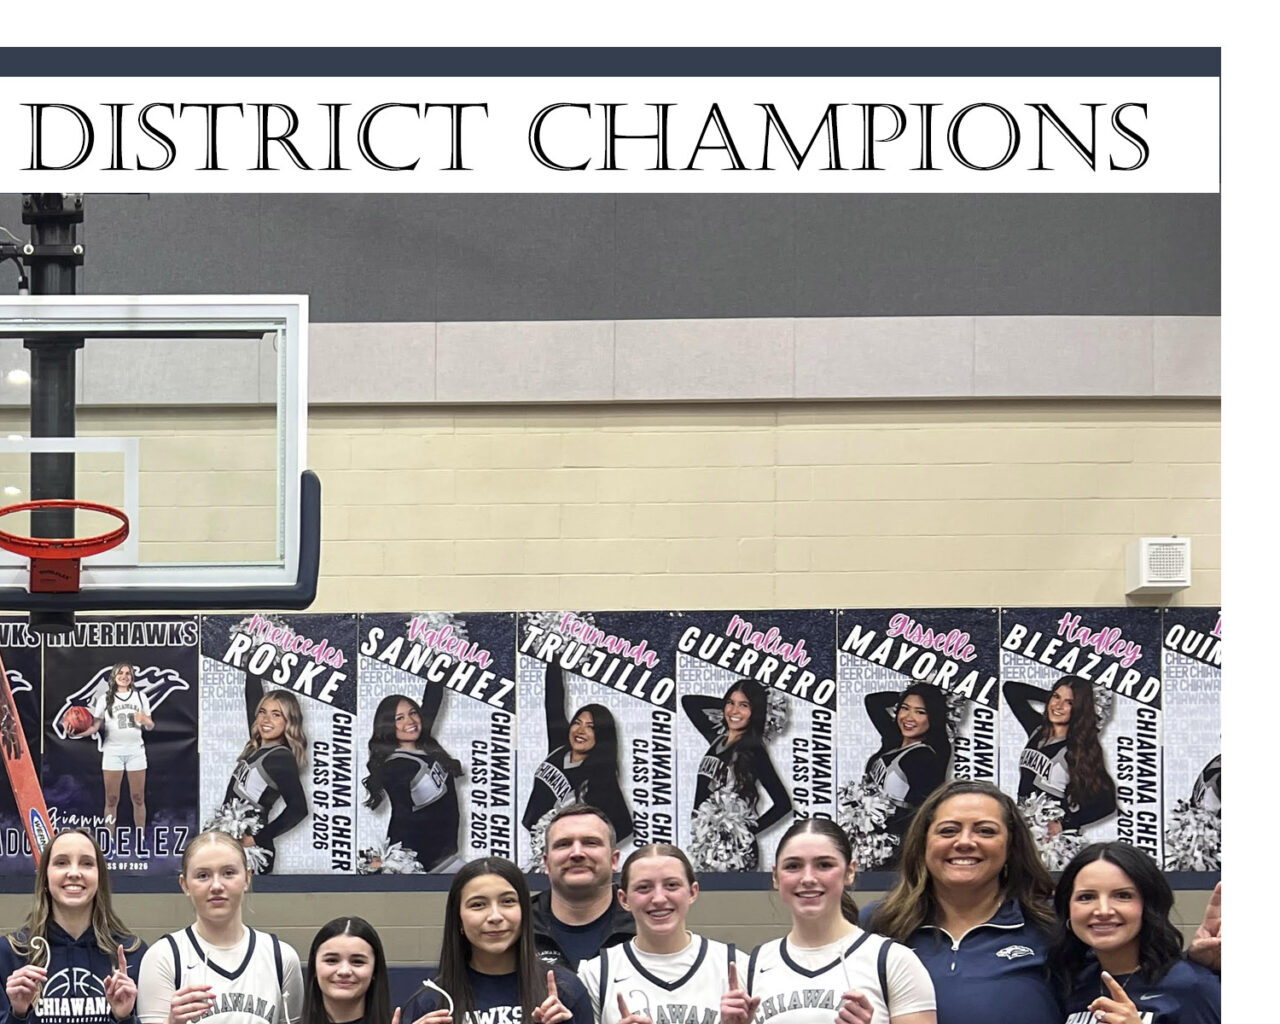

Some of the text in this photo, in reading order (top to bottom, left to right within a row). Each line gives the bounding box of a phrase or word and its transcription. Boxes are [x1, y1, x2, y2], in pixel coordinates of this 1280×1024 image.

[222, 632, 348, 704] ROSKE
[248, 613, 348, 669] Mercedes
[360, 626, 515, 709] SANCHEZ
[409, 617, 494, 670] Valeria
[519, 624, 675, 706] TRUJILLO
[559, 612, 660, 668] Fernanda
[678, 626, 836, 705] GUERRERO
[725, 614, 811, 668] Maliah
[841, 624, 998, 705] MAYORAL
[886, 612, 978, 663] Gisselle
[1002, 623, 1161, 704] BLEAZARD
[1057, 611, 1143, 668] Hadley
[651, 710, 672, 806] CHIAWANA
[792, 737, 809, 783] CLASS
[811, 709, 832, 805] CHIAWANA
[973, 708, 994, 780] CHIAWA
[1117, 736, 1134, 782] CLASS
[1136, 708, 1157, 804] CHIAWANA
[313, 741, 329, 851] CLASS OF 2026
[331, 713, 352, 871] CHIAWANA CHEER
[471, 740, 488, 849] CLASS OF 2026
[490, 712, 511, 859] CHIAWANA CHEE
[632, 738, 649, 848] CLASS OF 2026
[792, 787, 809, 807] OF
[1117, 786, 1134, 805] OF
[118, 862, 128, 871] OF
[129, 862, 148, 871] 2026
